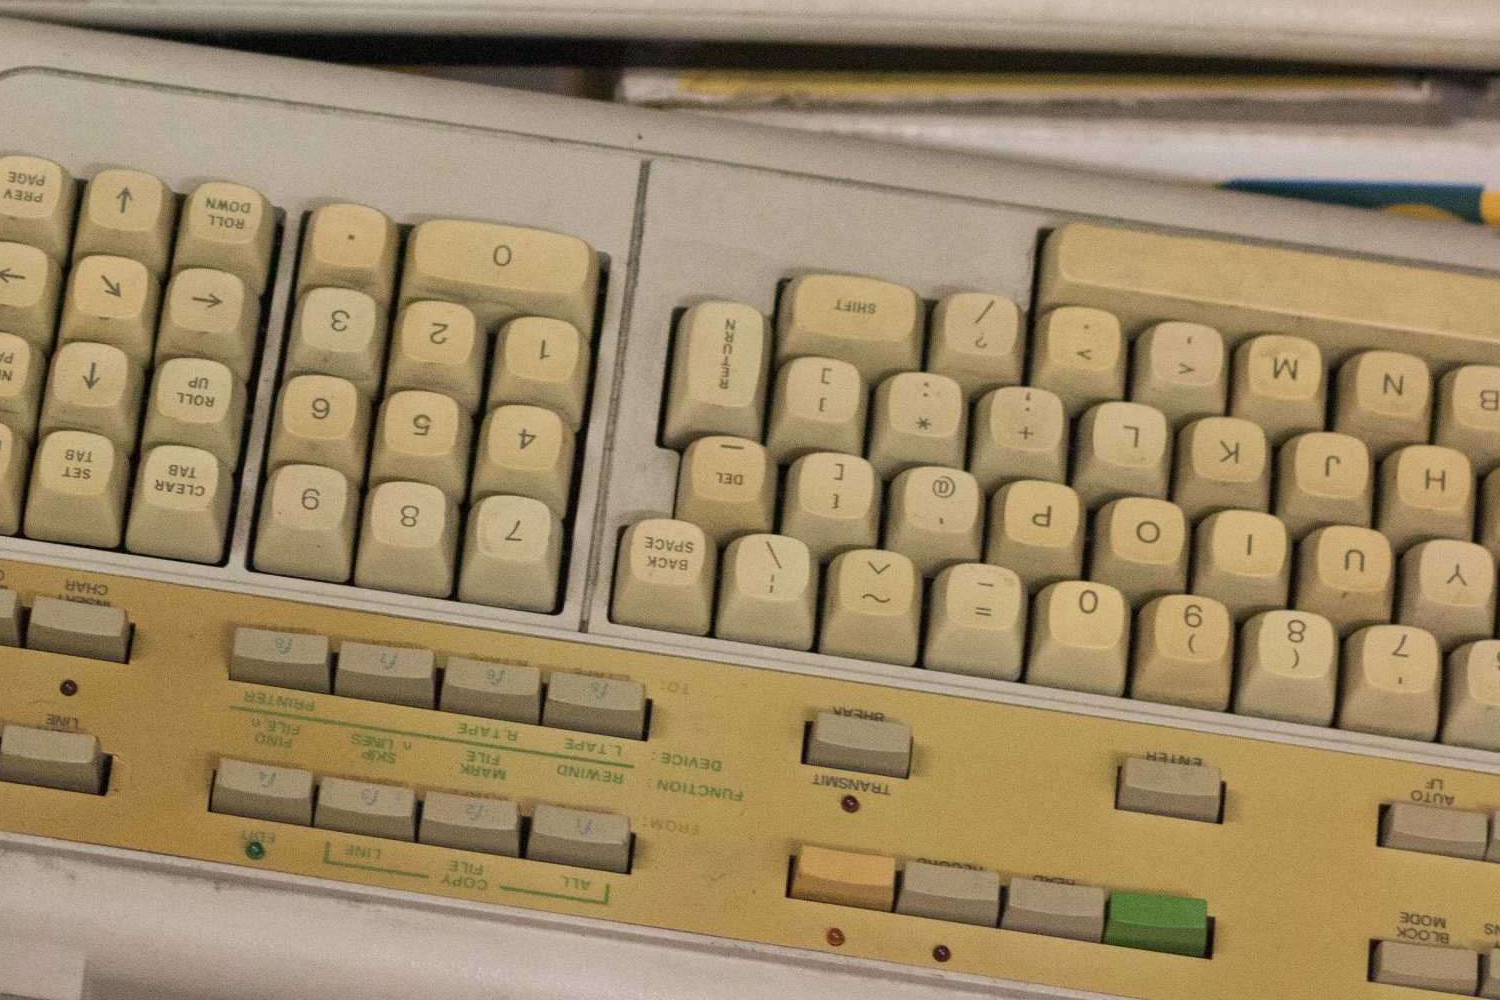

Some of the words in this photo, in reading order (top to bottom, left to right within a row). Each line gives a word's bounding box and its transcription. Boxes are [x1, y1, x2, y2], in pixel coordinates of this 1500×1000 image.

[8, 171, 46, 186] PAGE
[3, 188, 43, 203] PREV
[205, 198, 251, 214] DOWN
[207, 214, 244, 230] ROLL
[834, 299, 876, 314] SHIFT
[331, 311, 350, 332] 3
[429, 322, 448, 344] 2
[539, 339, 550, 360] 1
[719, 319, 736, 389] RETURN
[1273, 357, 1298, 380] M
[188, 377, 209, 389] UP
[1383, 373, 1404, 396] N
[176, 392, 215, 408] ROLL
[311, 398, 330, 420] 6
[1480, 390, 1499, 411] B
[412, 414, 431, 436] 5
[518, 428, 536, 450] 4
[1123, 425, 1139, 448] L
[64, 449, 93, 463] TAB
[1219, 440, 1239, 464] K
[62, 466, 91, 480] SET
[168, 464, 196, 479] TAB
[1325, 455, 1341, 477] J
[154, 479, 205, 497] CLEAR
[715, 472, 744, 486] DEL
[932, 476, 956, 498] @
[1424, 469, 1446, 491] H
[301, 489, 320, 511] 9
[400, 505, 419, 528] 8
[1031, 506, 1051, 527] P
[505, 520, 523, 542] 7
[1136, 521, 1160, 543] O
[644, 536, 694, 553] SPACE
[646, 556, 688, 571] BACK
[1344, 549, 1364, 572] U
[1446, 564, 1467, 586] Y
[65, 579, 108, 596] CHAR
[1184, 604, 1202, 628] 9
[1288, 619, 1306, 643] 8
[1392, 634, 1409, 658] 7
[243, 691, 315, 712] PRINTER
[46, 713, 79, 729] LINE
[267, 719, 300, 735] FILE
[254, 732, 292, 749] FIND
[350, 733, 393, 749] LINES
[360, 751, 396, 764] SKIP
[465, 750, 500, 765] FILE
[460, 764, 506, 781] MARK
[556, 764, 623, 784] REWIND
[812, 773, 891, 796] TRANSMIT
[1426, 778, 1444, 790] LF
[1409, 789, 1454, 806] AUTO
[342, 844, 381, 860] LINE
[449, 860, 484, 876] FILE
[440, 874, 489, 891] COPY
[562, 876, 590, 890] ALL
[1399, 911, 1446, 929] MODE
[1396, 926, 1449, 945] BLOCK
